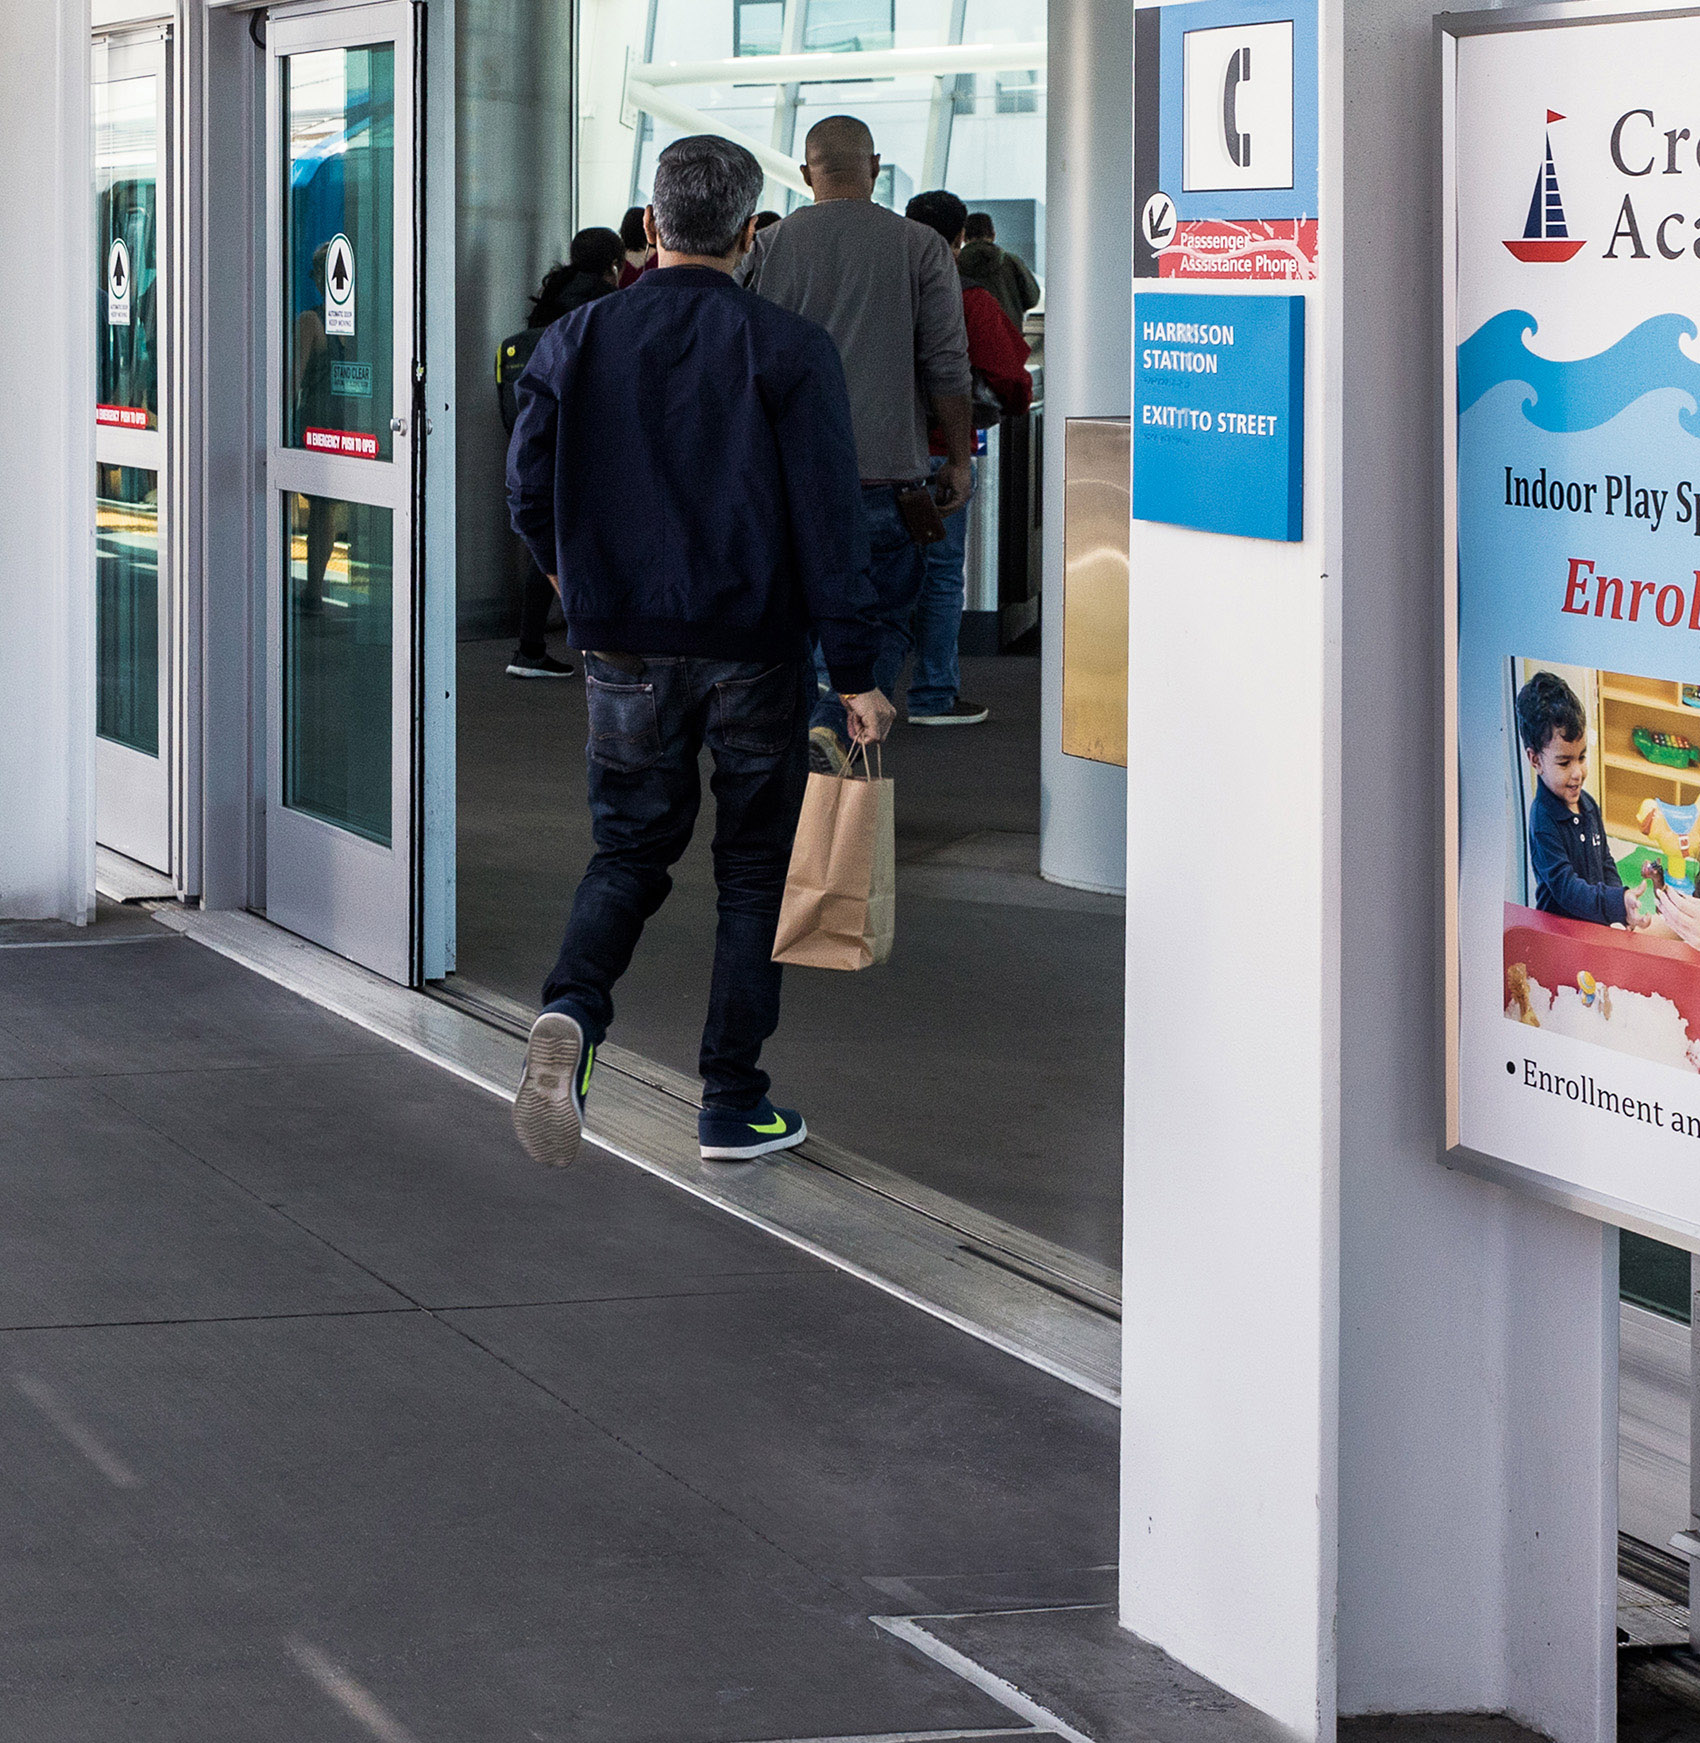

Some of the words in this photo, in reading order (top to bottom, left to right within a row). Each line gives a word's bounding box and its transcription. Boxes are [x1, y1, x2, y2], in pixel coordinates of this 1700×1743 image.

[1610, 109, 1700, 177] Cr
[1255, 254, 1297, 272] Phone
[333, 365, 350, 379] STAND
[351, 366, 370, 381] CLEAR
[1217, 412, 1278, 436] STREET
[312, 432, 341, 449] EMERGENCY
[341, 436, 355, 451] PUSH
[355, 437, 362, 452] TO
[362, 438, 376, 454] OPEN
[1504, 466, 1598, 514] Indoor
[1605, 474, 1669, 532] Play
[1523, 1058, 1664, 1127] Enrollment
